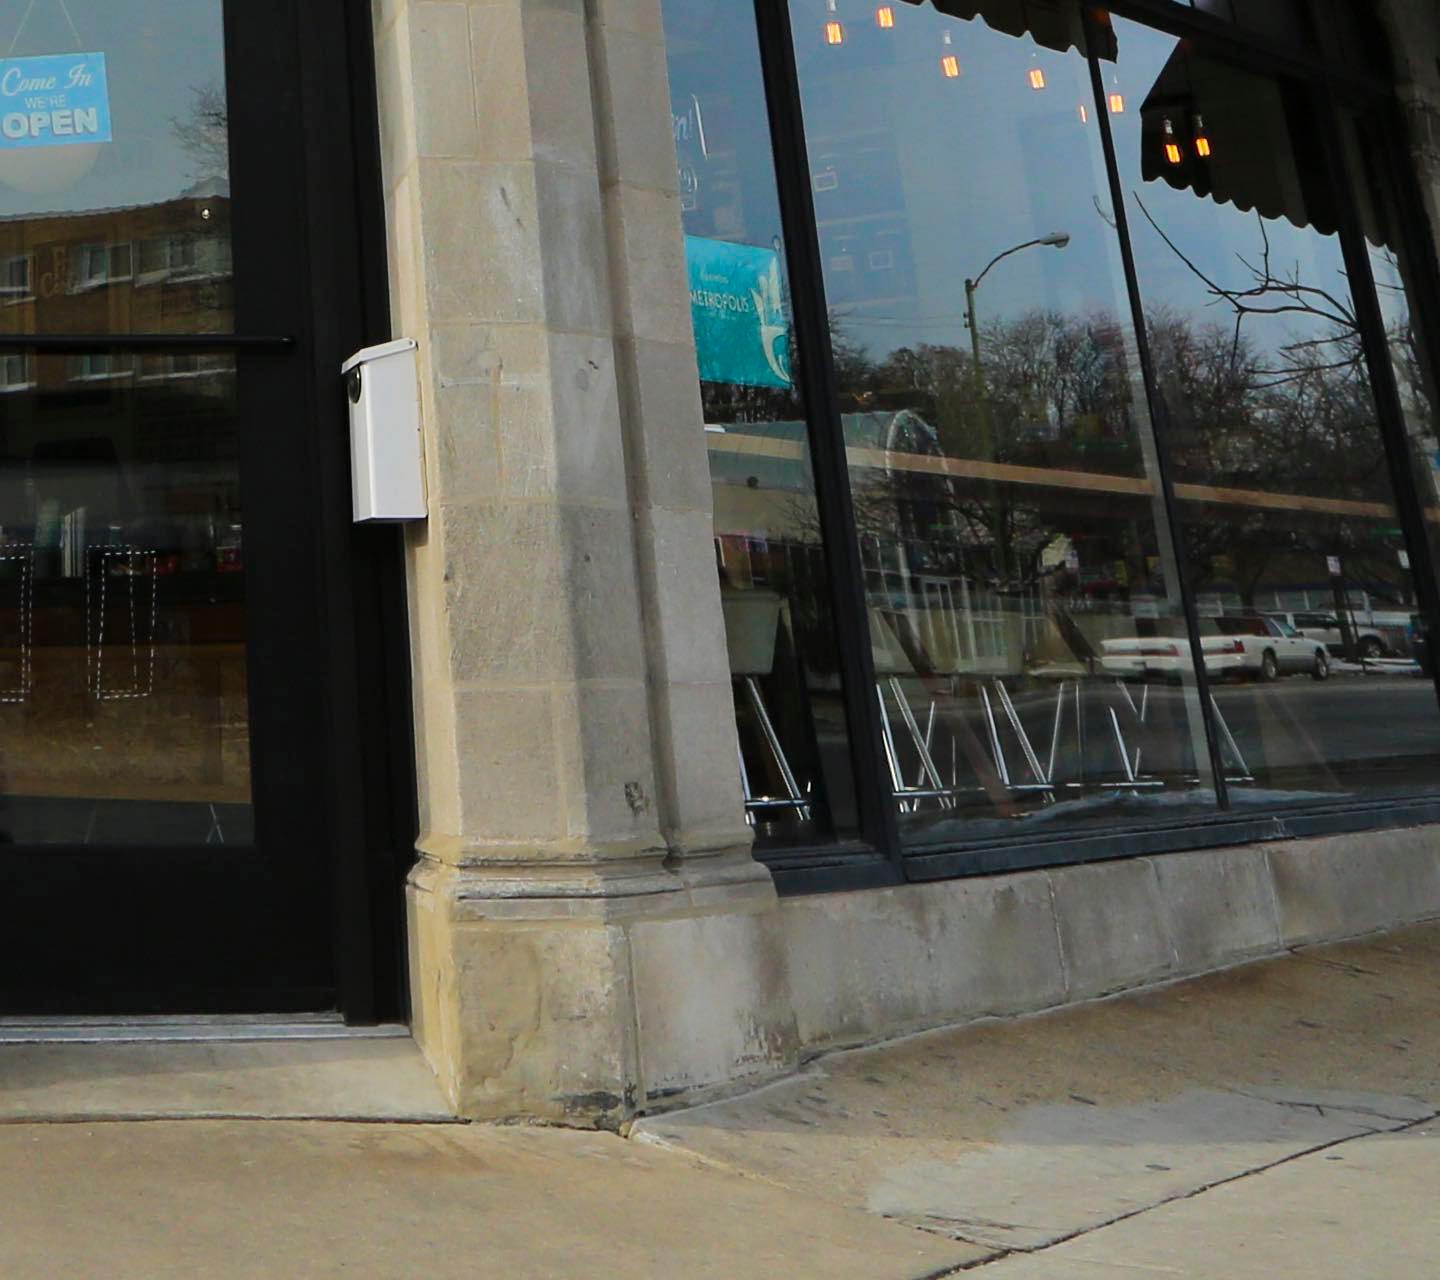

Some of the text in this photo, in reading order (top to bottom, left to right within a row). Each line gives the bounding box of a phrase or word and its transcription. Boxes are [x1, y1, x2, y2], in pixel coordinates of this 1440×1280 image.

[1, 63, 93, 96] Come In
[24, 94, 66, 109] WE'RE
[1, 106, 99, 139] OPEN
